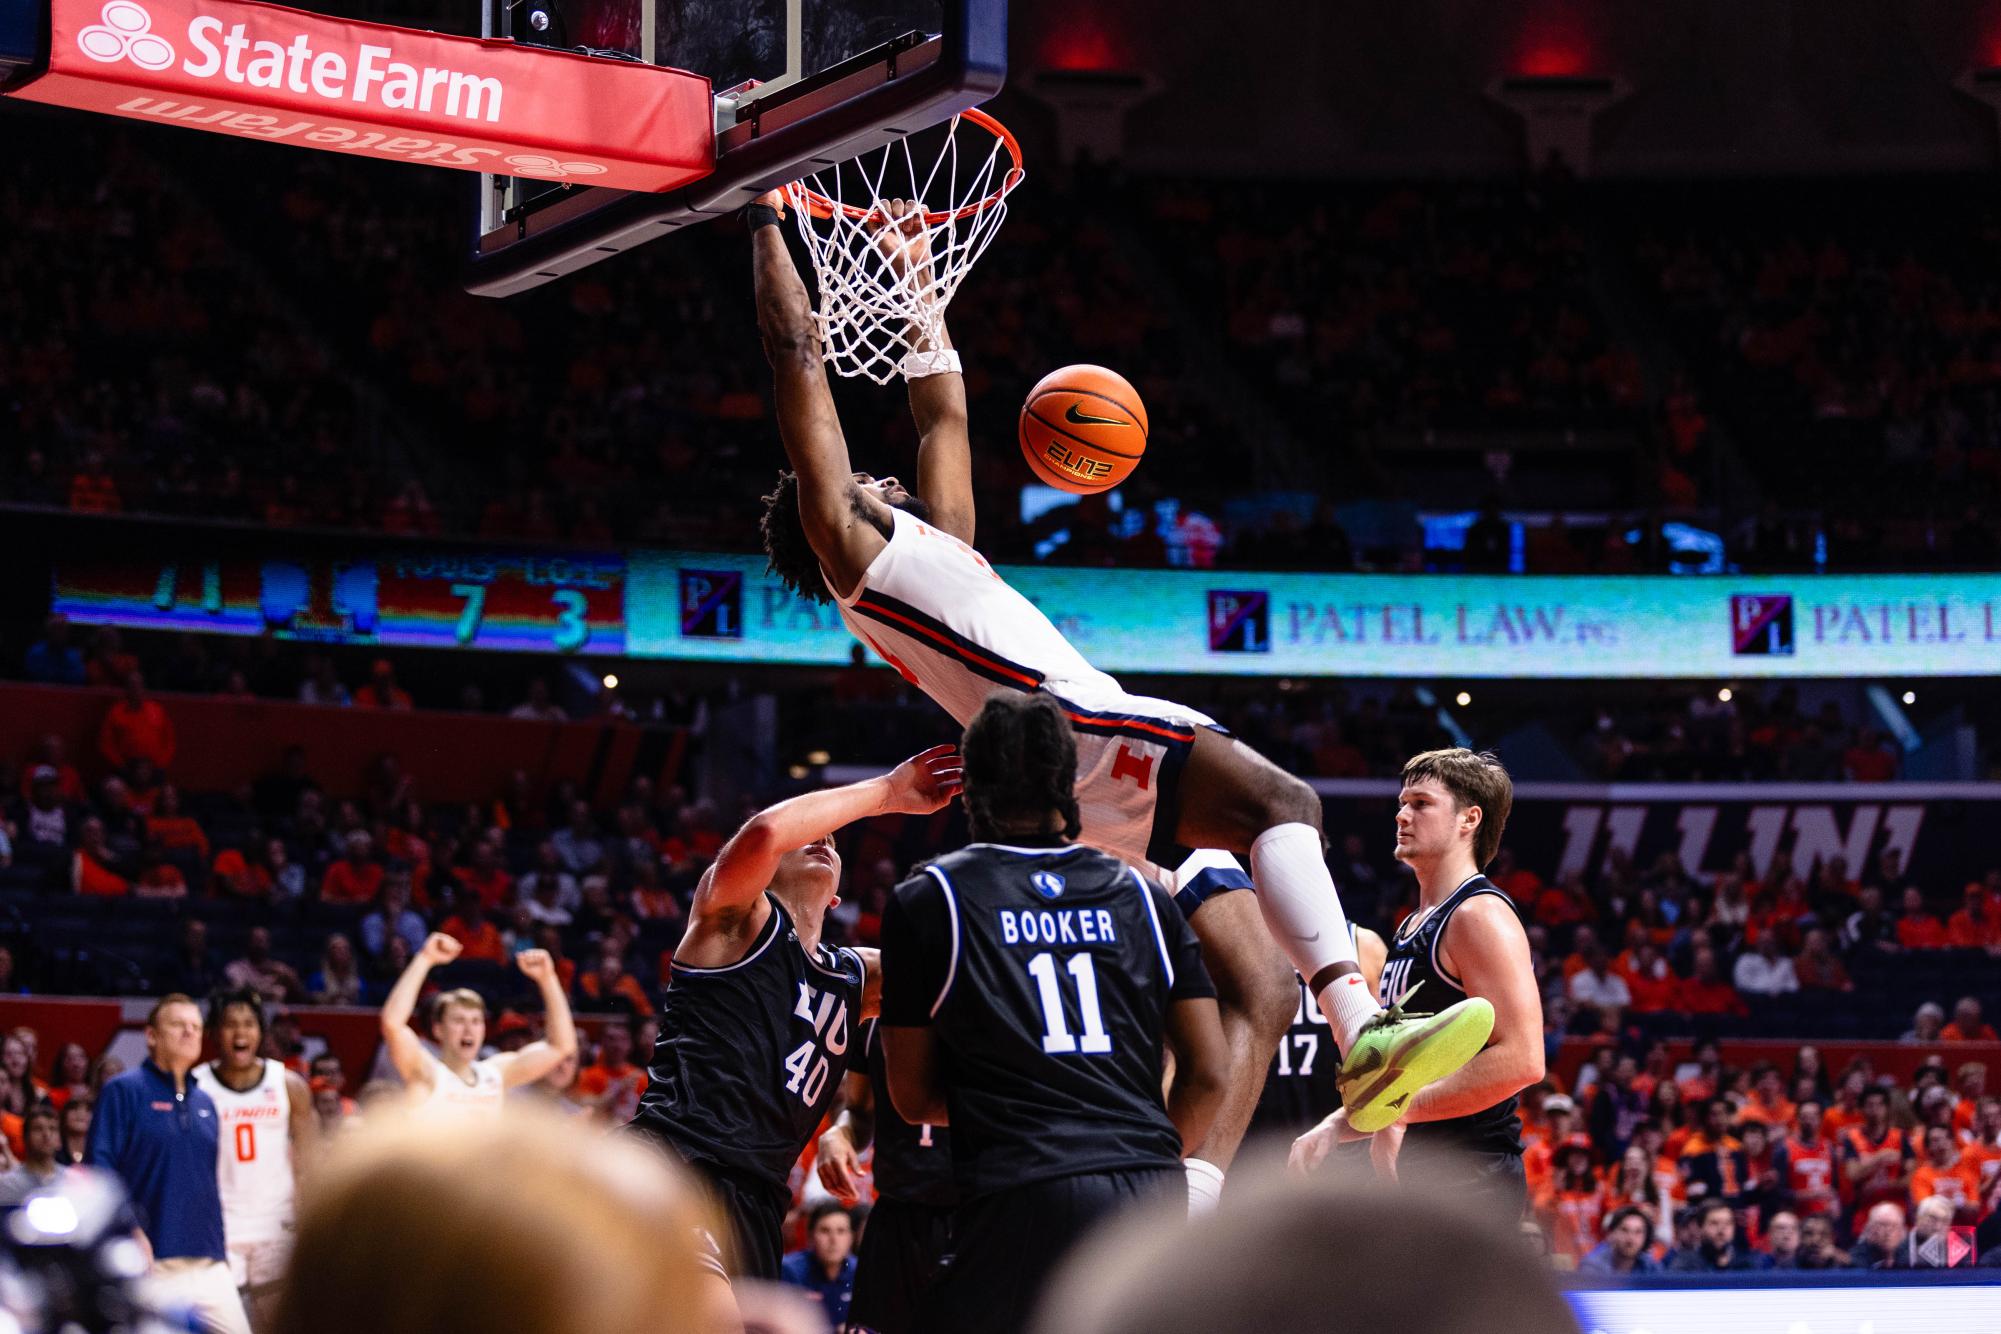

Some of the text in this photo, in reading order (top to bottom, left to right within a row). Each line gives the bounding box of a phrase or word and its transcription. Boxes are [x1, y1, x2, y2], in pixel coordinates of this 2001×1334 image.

[1046, 440, 1114, 477] ELITE
[452, 584, 486, 642] 7
[552, 589, 588, 650] 3
[1288, 603, 1440, 644] PATEL
[1814, 603, 1966, 642] PATEL
[1000, 910, 1116, 944] BOOKER
[1027, 952, 1112, 1054] 11
[785, 1040, 829, 1107] 40
[1278, 1034, 1319, 1077] 17
[236, 1123, 256, 1162] 0
